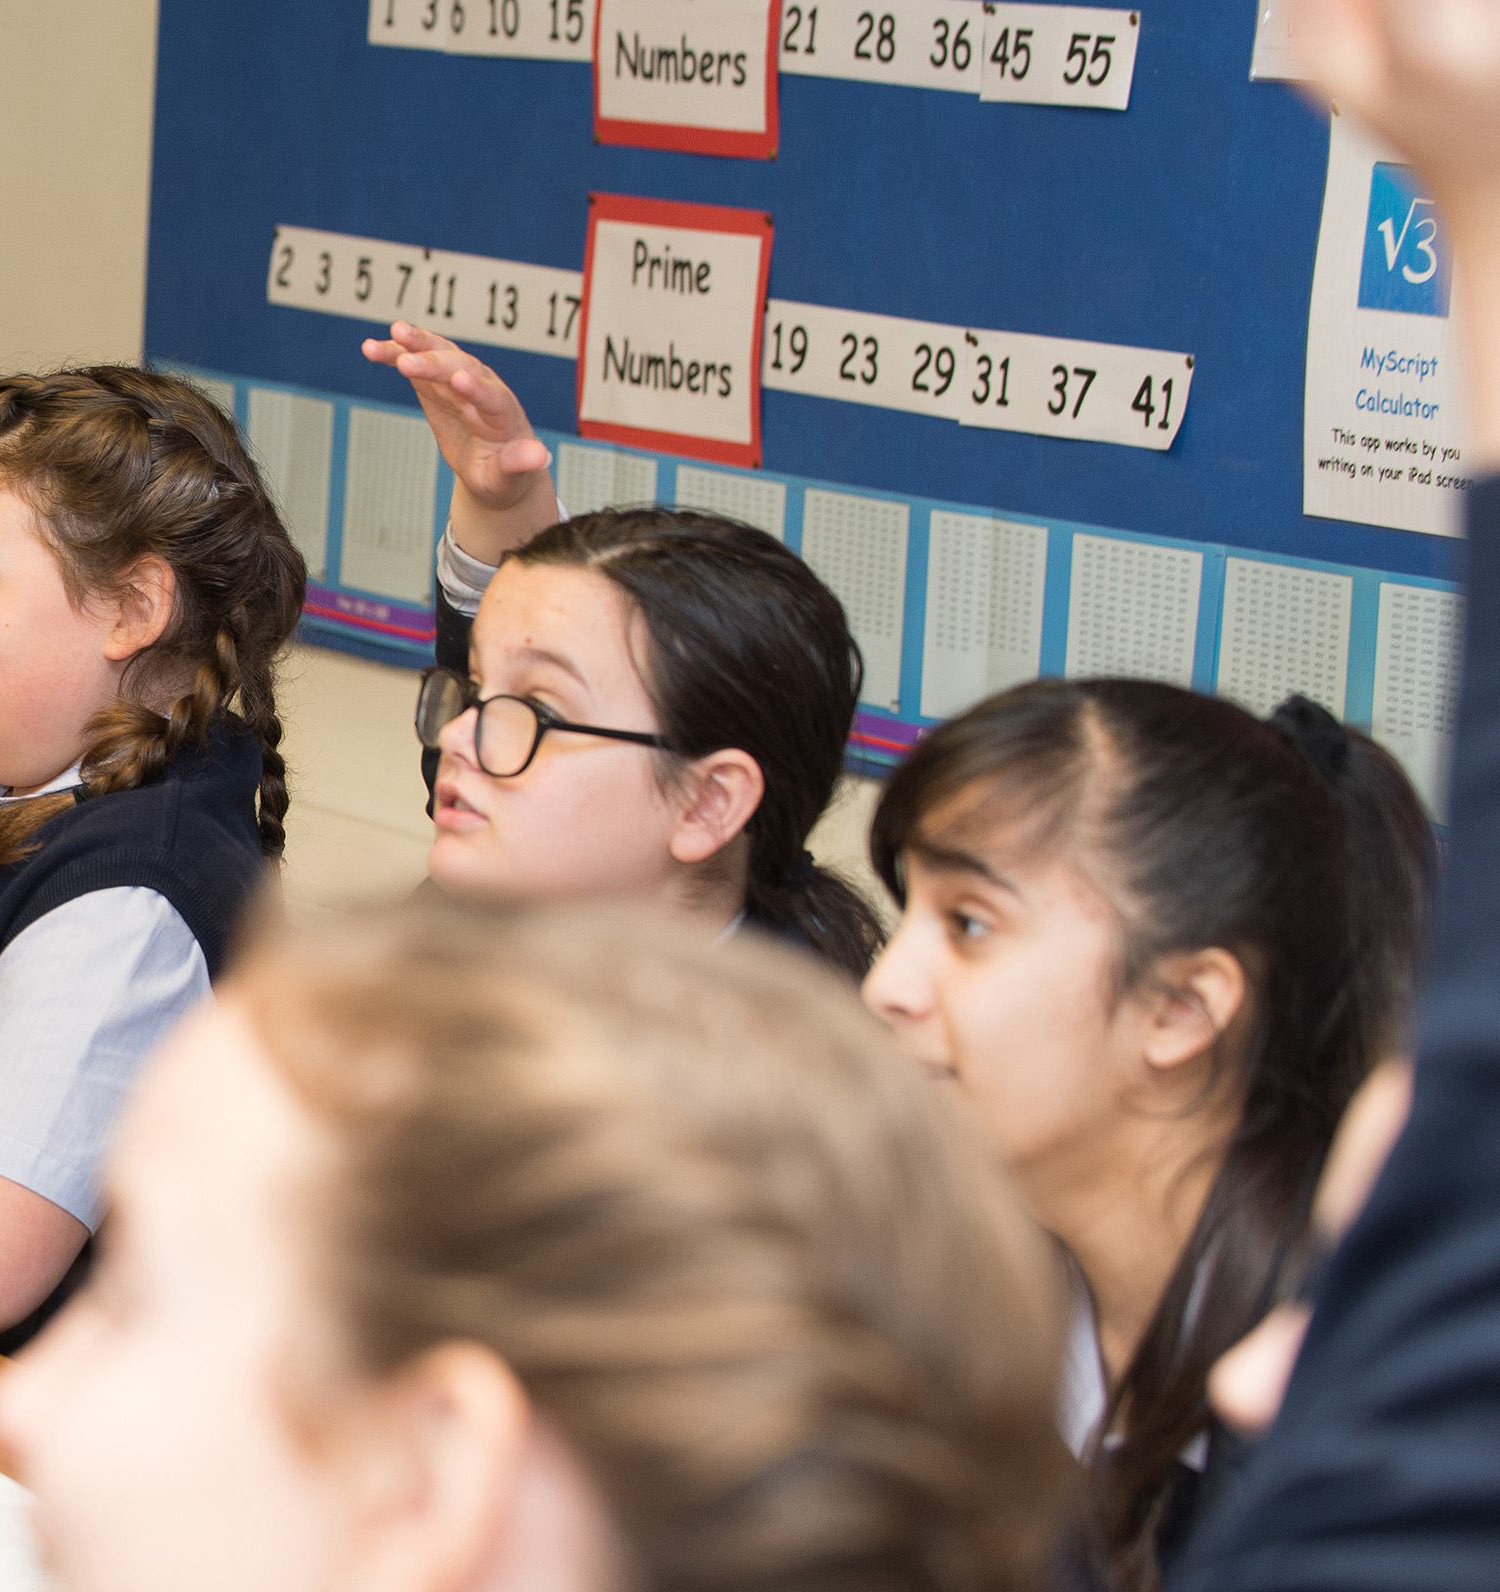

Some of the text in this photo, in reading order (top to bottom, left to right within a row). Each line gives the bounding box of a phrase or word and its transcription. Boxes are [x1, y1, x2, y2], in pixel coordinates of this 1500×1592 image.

[421, 0, 438, 30] 3
[449, 0, 466, 35] 6
[487, 0, 520, 38] 10
[548, 0, 585, 43] 15
[783, 5, 1117, 87] 21 28 36 45 55
[614, 30, 748, 88] Numbers
[275, 246, 582, 341] 2 3 5 7 11 13 17
[632, 239, 712, 296] Prime
[602, 334, 733, 398] Numbers
[771, 321, 1175, 430] 19 23 29 31 37 41
[1359, 346, 1439, 383] MyScript
[1354, 390, 1440, 420] Calculator
[1317, 457, 1357, 480] writing
[1360, 464, 1374, 478] on
[1377, 465, 1403, 484] your
[1407, 467, 1432, 487] iPad
[1331, 428, 1461, 463] This app works by you
